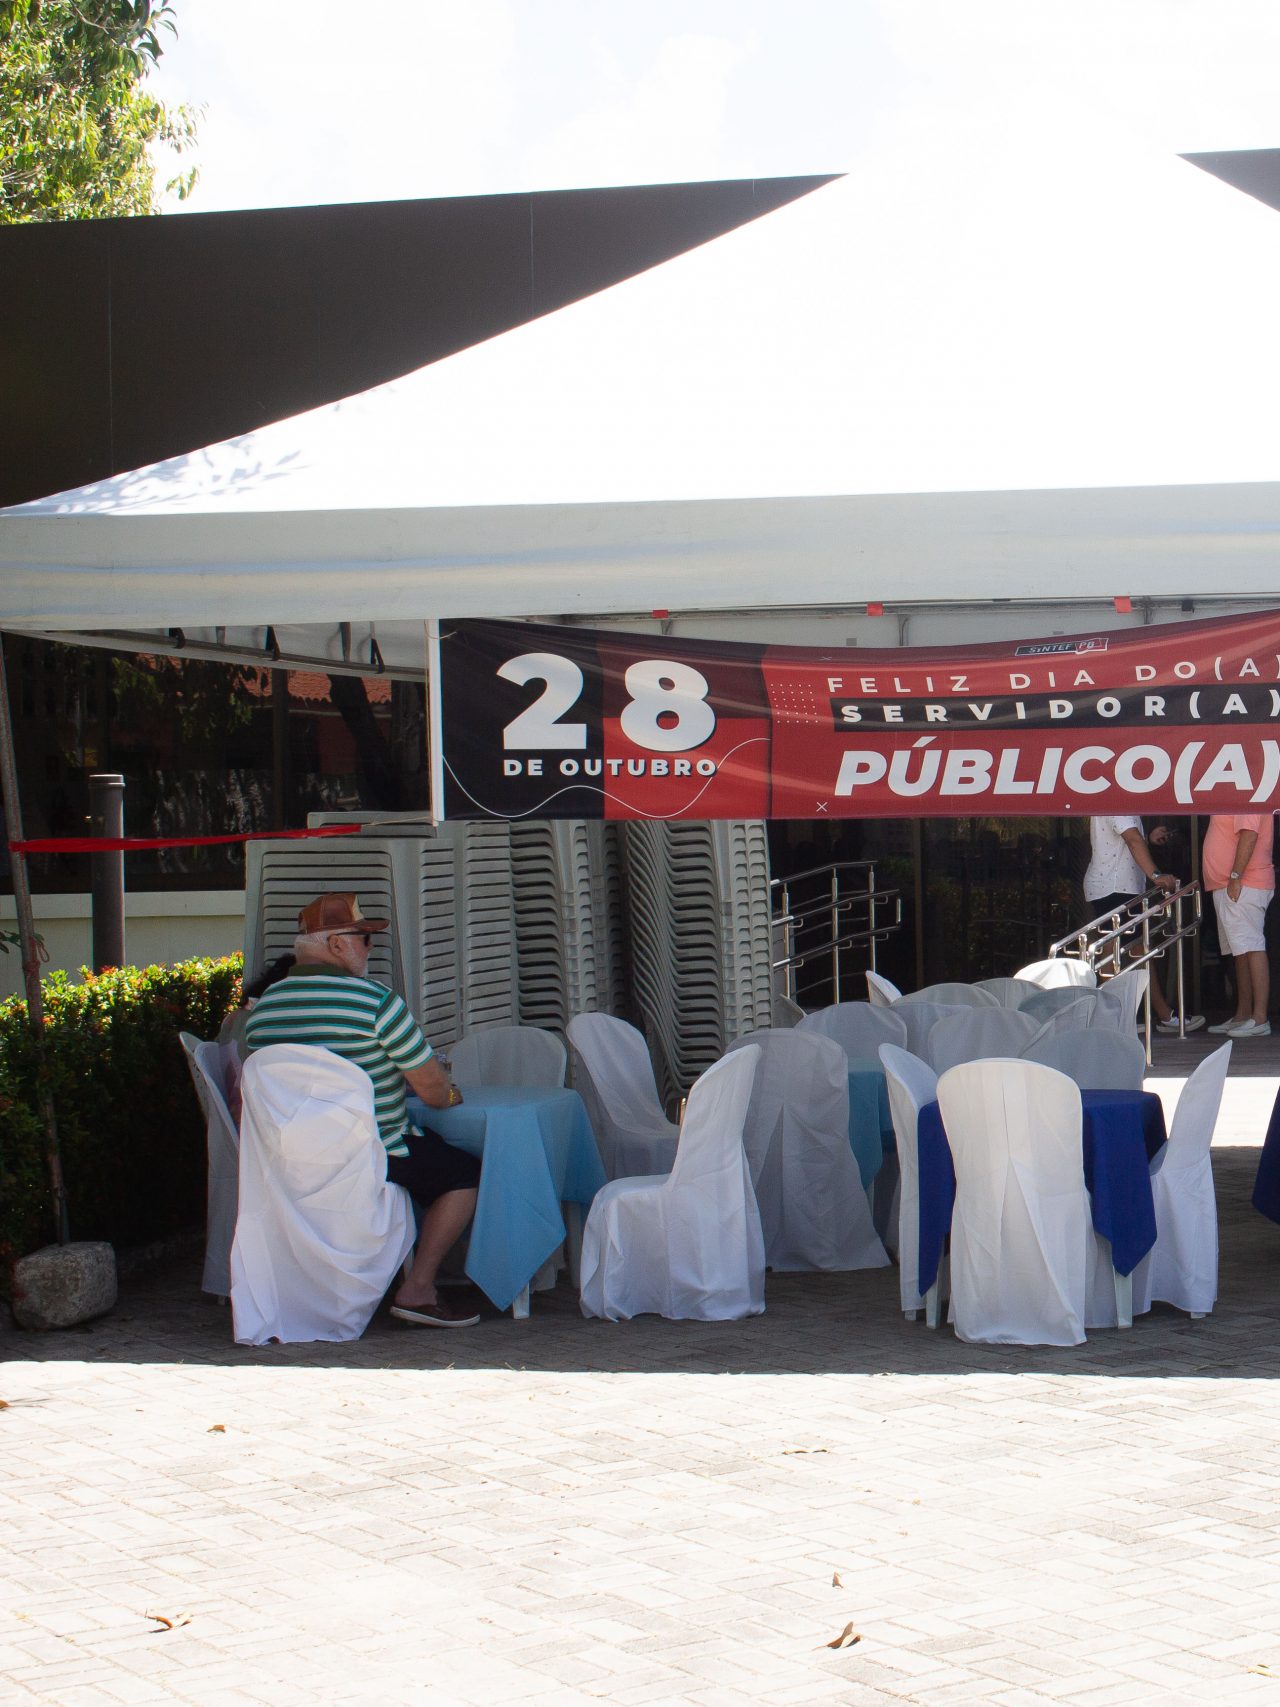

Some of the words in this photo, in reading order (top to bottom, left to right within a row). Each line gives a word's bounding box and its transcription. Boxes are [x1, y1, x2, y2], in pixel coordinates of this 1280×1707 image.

[827, 675, 970, 693] FELIZ
[1009, 669, 1096, 690] DIA
[496, 652, 716, 752] 28
[841, 689, 1280, 723] SERVIDOR(A)
[503, 758, 544, 776] DE
[559, 758, 718, 777] OUTUBRO
[834, 736, 1280, 804] PÚBLICO(A)
